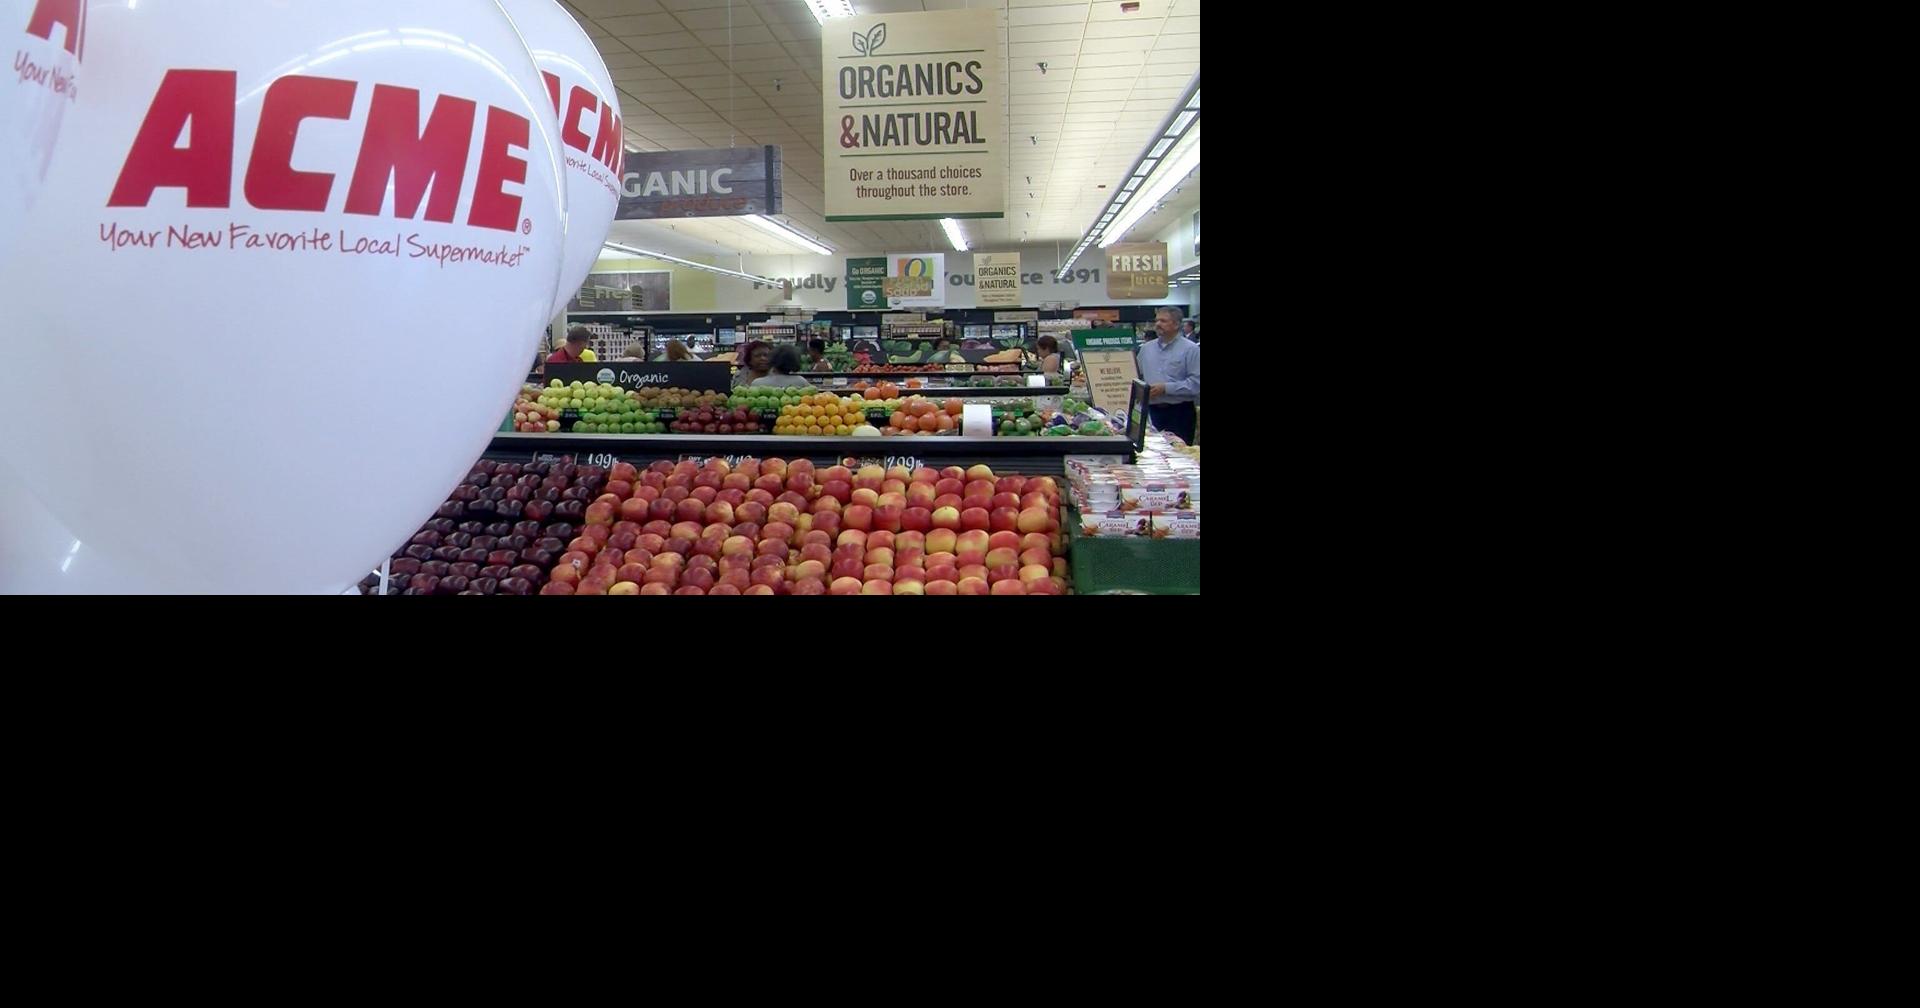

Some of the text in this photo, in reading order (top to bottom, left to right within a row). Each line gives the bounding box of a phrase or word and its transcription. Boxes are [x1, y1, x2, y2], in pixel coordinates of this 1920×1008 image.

[839, 60, 983, 100] ORGANICS
[840, 110, 986, 149] &NATURAL
[106, 69, 530, 232] ACME
[850, 165, 982, 181] Over a thousand choices
[856, 184, 972, 200] throughout the store.
[100, 222, 161, 251] Your
[167, 224, 222, 249] New
[229, 222, 333, 250] Favorite
[340, 230, 401, 257] Local
[979, 266, 1017, 277] ORGANICS
[1112, 254, 1163, 272] FRESH
[619, 370, 669, 388] Organic
